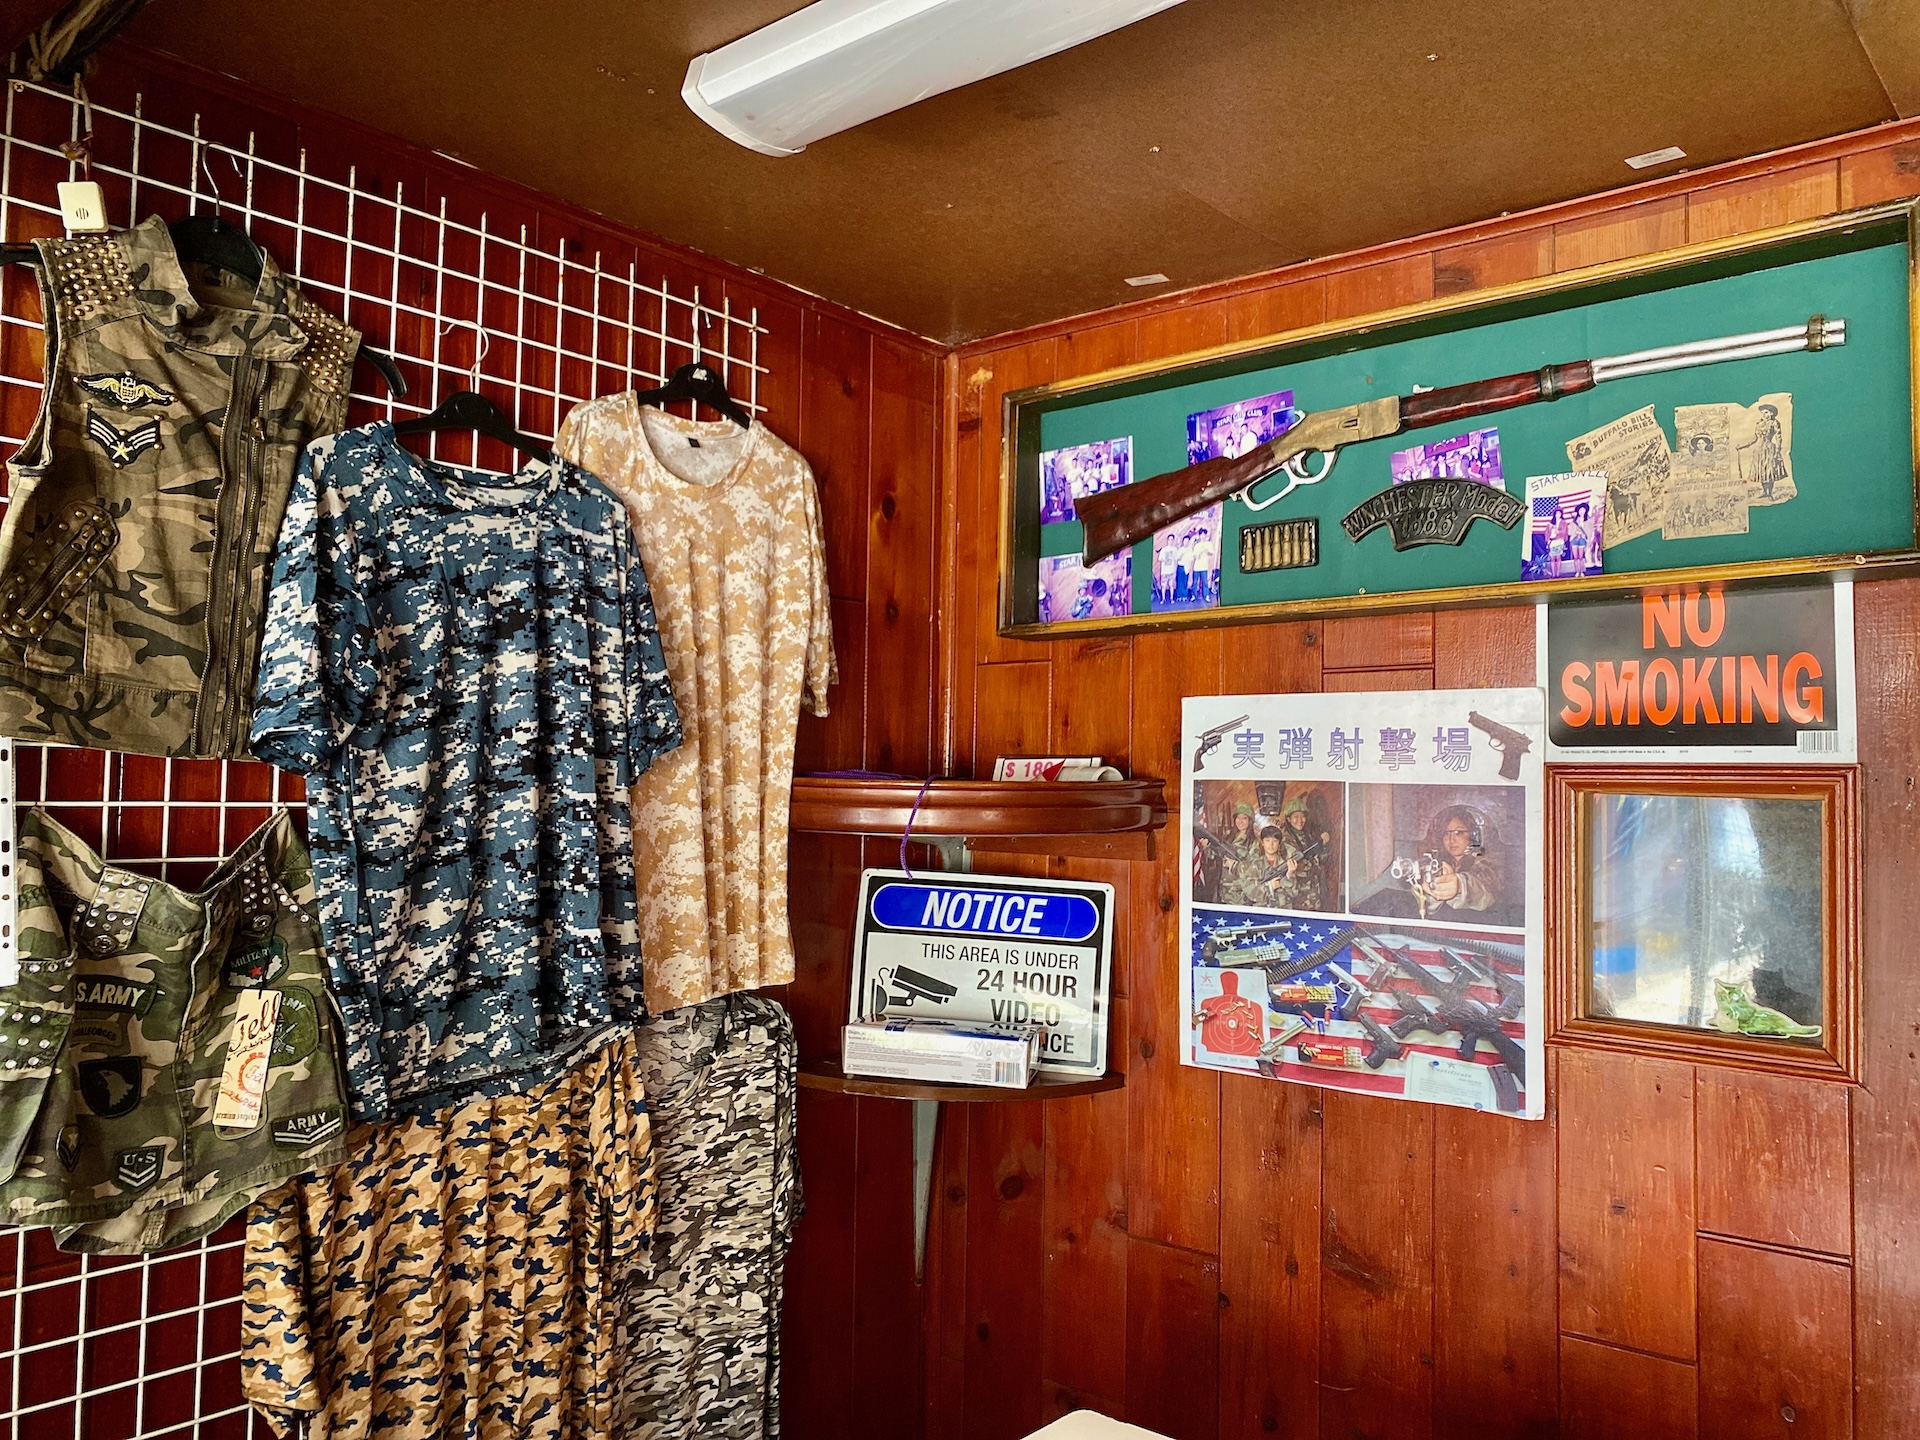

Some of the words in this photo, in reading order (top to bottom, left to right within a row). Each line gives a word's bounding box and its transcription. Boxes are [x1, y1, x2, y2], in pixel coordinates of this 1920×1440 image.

[1592, 420, 1628, 448] BUFFALO
[1631, 413, 1650, 425] BILL
[1618, 418, 1654, 438] STORIES
[1531, 474, 1559, 492] STAR
[1345, 482, 1459, 536] WINCHESTER
[1460, 484, 1520, 523] Model
[1642, 588, 1726, 649] NO
[1560, 652, 1824, 727] SMOKING
[920, 890, 1048, 934] NOTICE
[230, 947, 272, 968] MILITARY
[922, 943, 955, 961] THIS
[959, 945, 1000, 963] AREA
[1005, 948, 1019, 965] IS
[1025, 950, 1079, 970] UNDER
[976, 969, 1005, 992] 24
[1013, 971, 1077, 998] HOUR
[282, 997, 306, 1011] MY
[990, 998, 1060, 1027] VIDEO
[287, 1112, 326, 1132] ARMY
